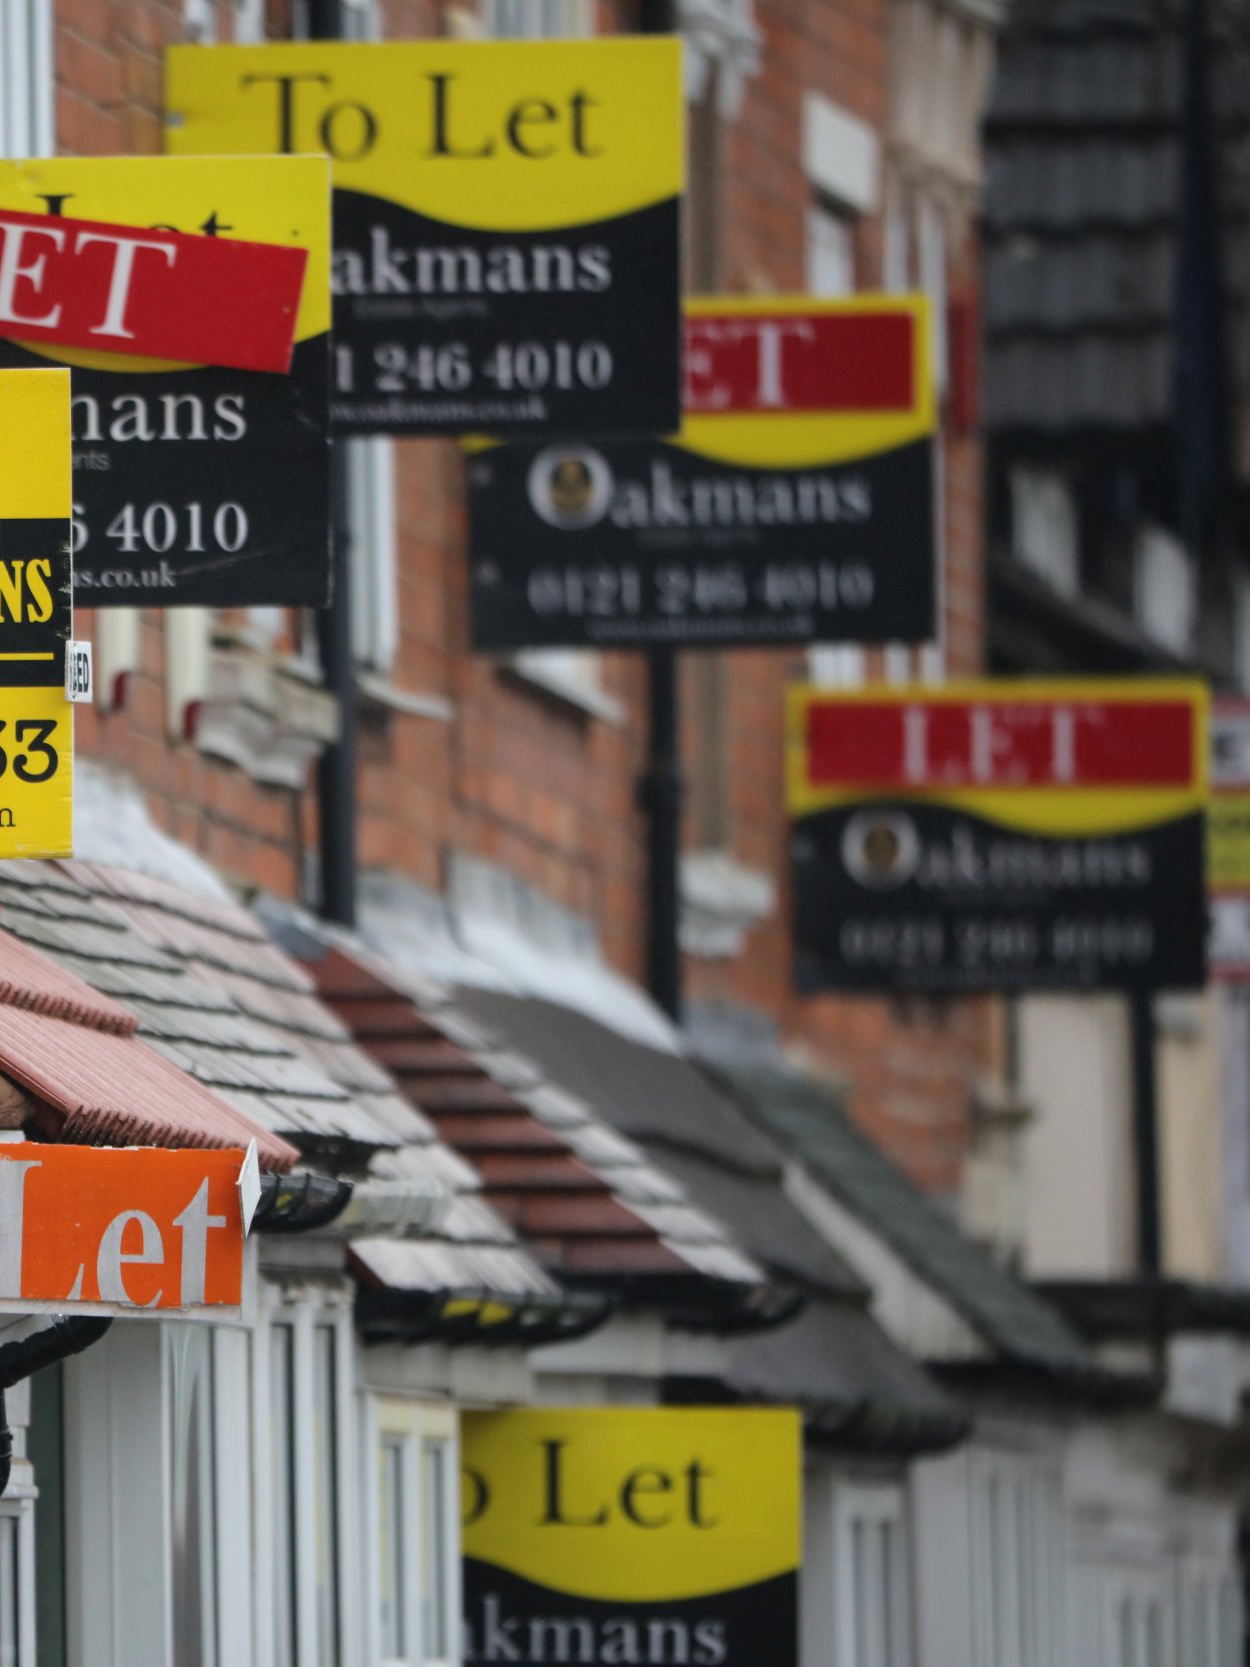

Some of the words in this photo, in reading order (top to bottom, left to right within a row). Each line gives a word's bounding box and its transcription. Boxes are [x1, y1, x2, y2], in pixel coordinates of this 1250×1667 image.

[239, 70, 380, 161] To
[423, 70, 604, 161] Let
[372, 341, 473, 393] 246
[481, 340, 614, 392] 4010
[105, 501, 249, 553] 4010
[527, 442, 872, 529] Oakmans
[900, 702, 1107, 787] LET
[534, 1435, 719, 1530] Let
